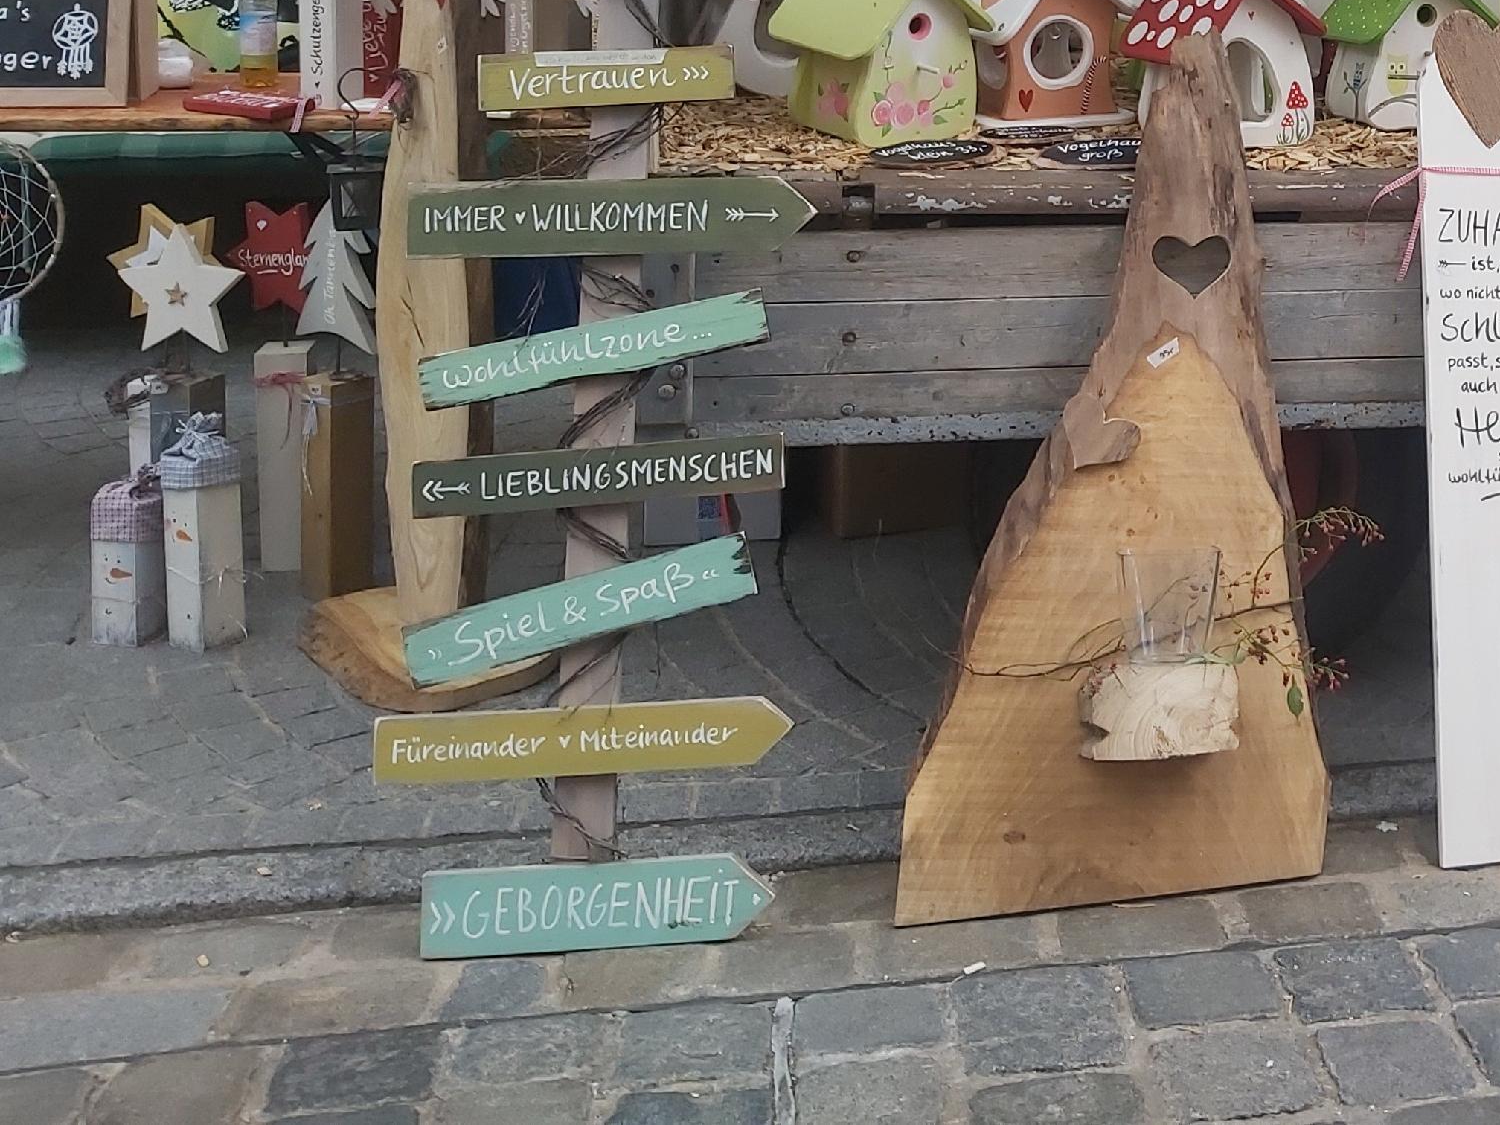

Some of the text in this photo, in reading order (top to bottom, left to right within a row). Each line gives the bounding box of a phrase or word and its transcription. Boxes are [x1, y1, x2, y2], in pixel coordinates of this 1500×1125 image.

[509, 65, 677, 101] Vertrauen
[1057, 139, 1142, 155] Vogelhau
[1078, 148, 1123, 163] groß
[423, 199, 709, 234] IMMER WILLKOMMEN
[1471, 254, 1500, 274] ist,
[1439, 287, 1462, 300] wo
[1460, 375, 1498, 393] auch
[480, 447, 774, 502] LIEBLINGSMENSCHEN
[447, 562, 695, 668] Spiel & Spaß
[391, 723, 739, 765] Füreinander Miteinander
[461, 875, 741, 939] GEBORGENHEIT
